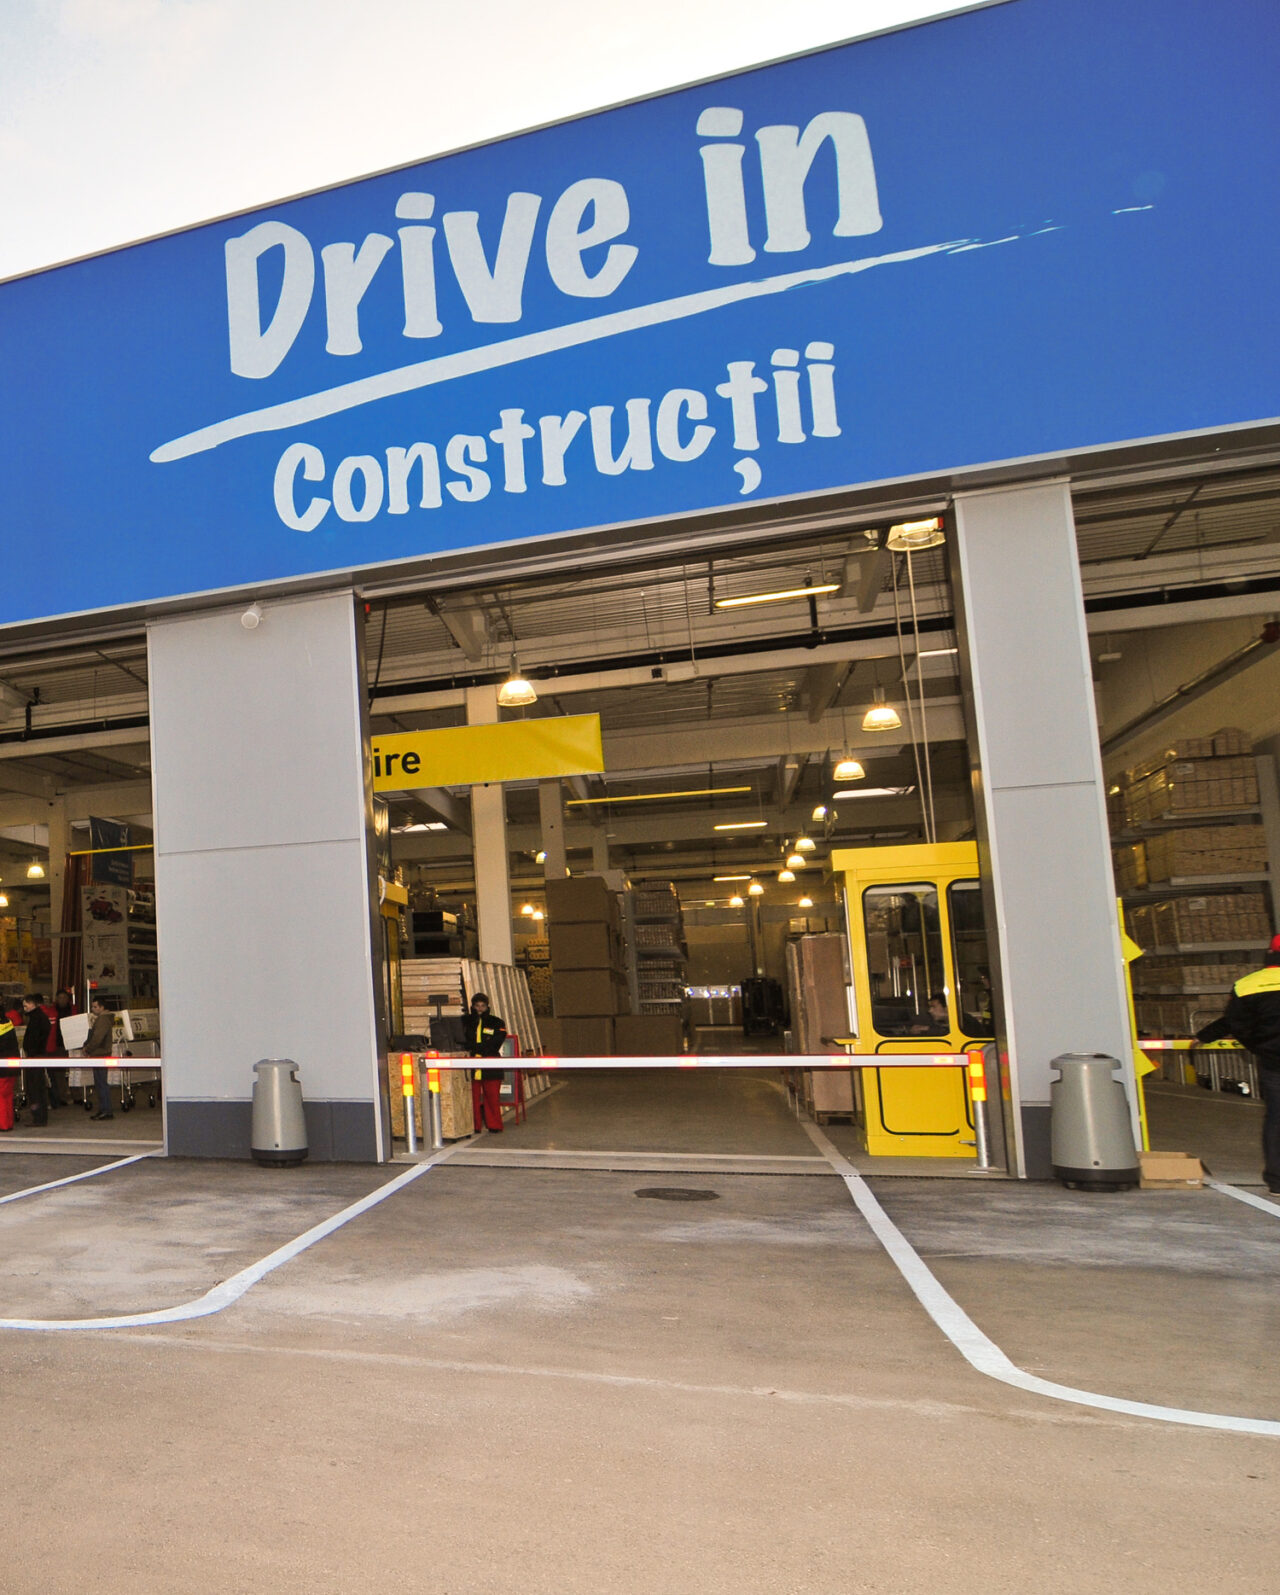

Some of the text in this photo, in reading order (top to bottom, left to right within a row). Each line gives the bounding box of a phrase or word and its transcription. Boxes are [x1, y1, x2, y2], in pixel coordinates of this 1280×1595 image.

[224, 107, 883, 379] Drive in
[274, 341, 841, 532] Construcții
[373, 747, 421, 778] ire
